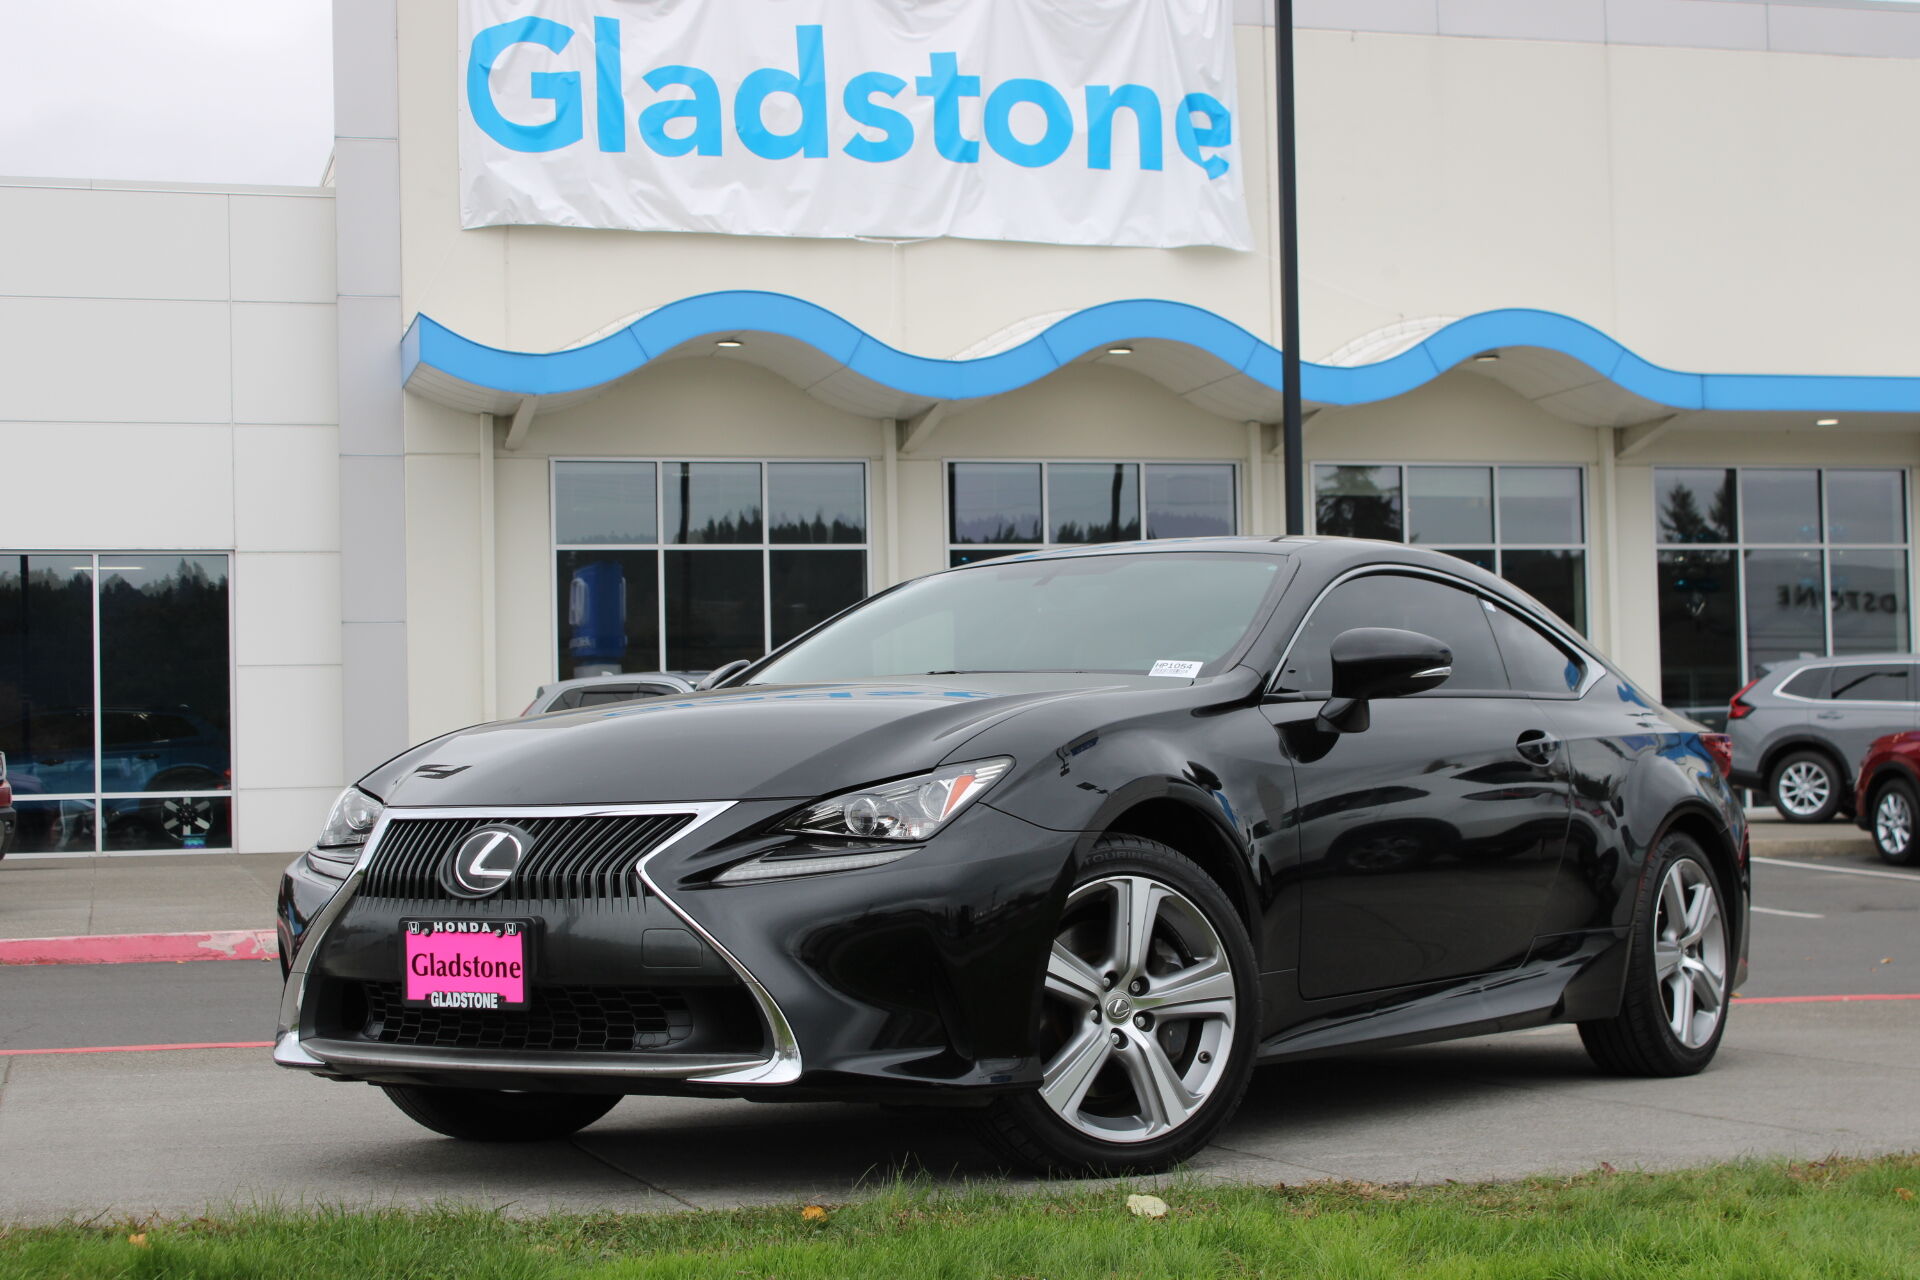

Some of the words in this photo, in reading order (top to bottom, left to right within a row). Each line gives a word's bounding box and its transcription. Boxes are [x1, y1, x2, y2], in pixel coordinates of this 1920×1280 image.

[467, 15, 1232, 181] Gladstone
[433, 922, 491, 933] HONDA
[411, 953, 521, 978] Gladstone
[430, 991, 498, 1009] GLADSTONE
